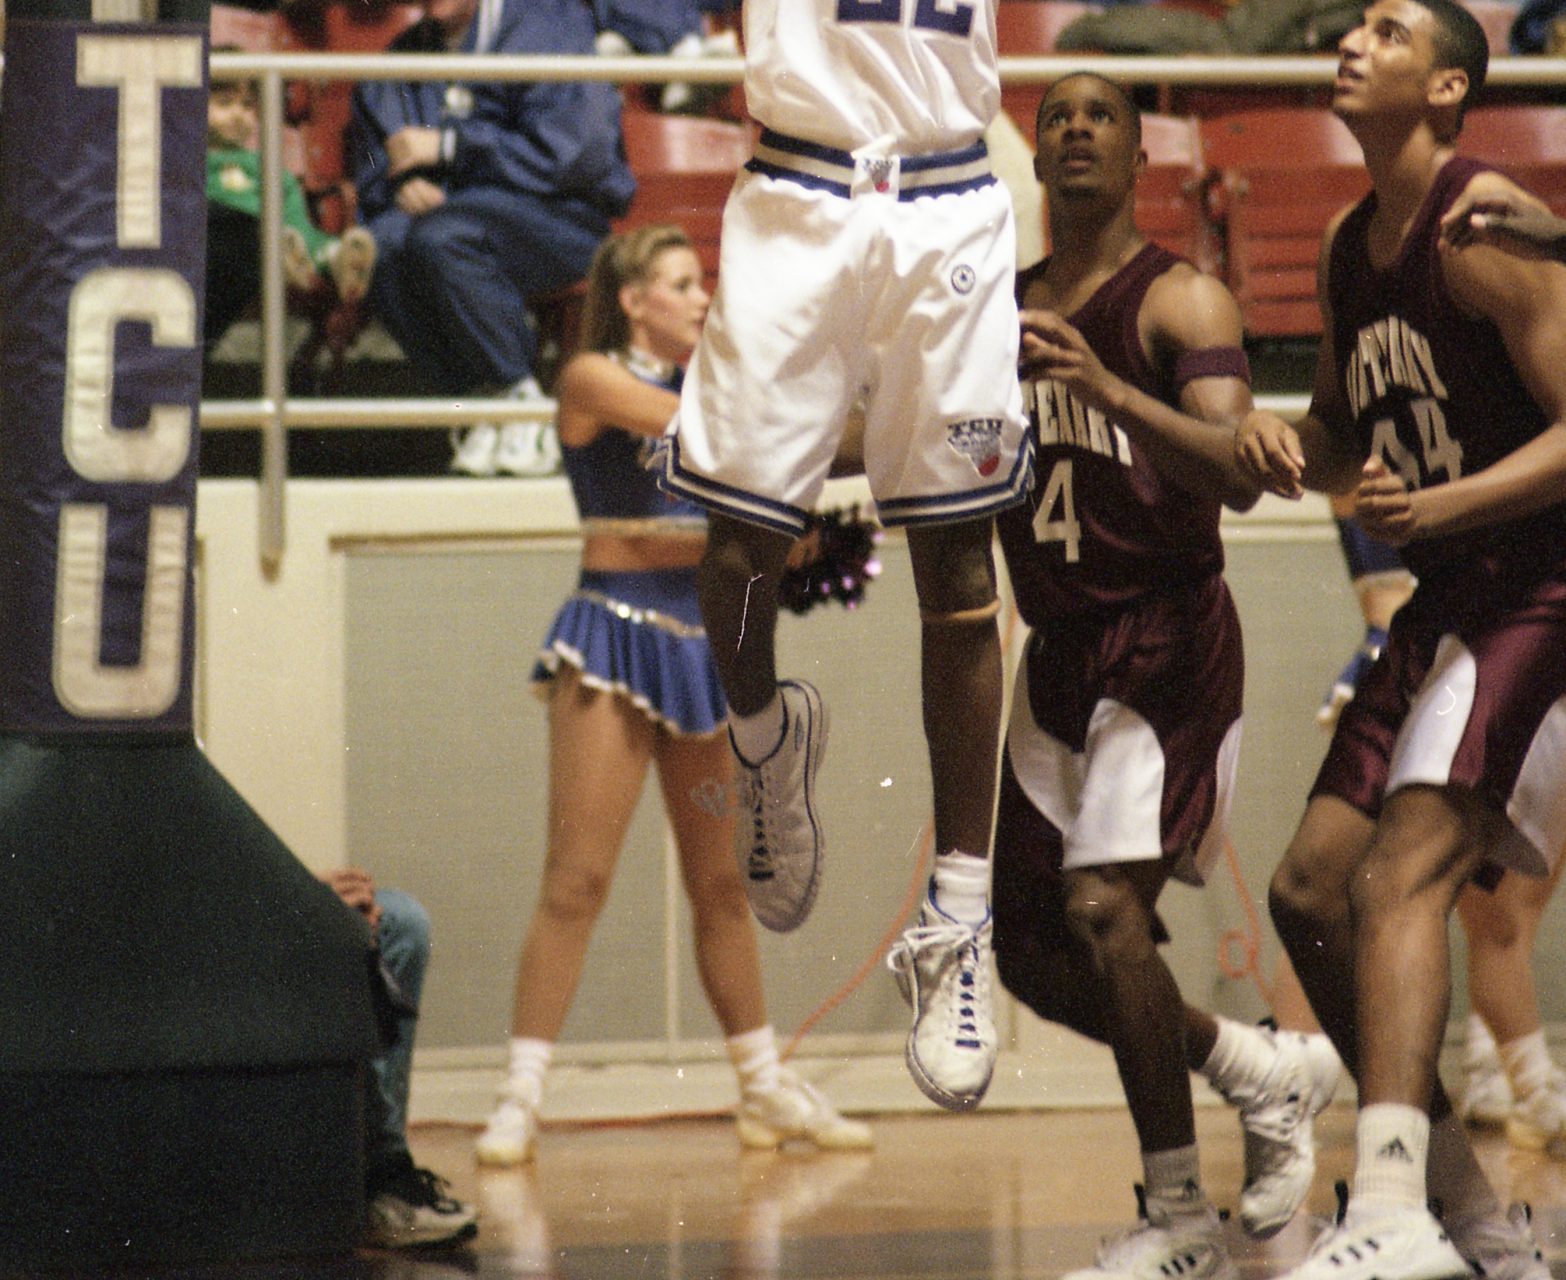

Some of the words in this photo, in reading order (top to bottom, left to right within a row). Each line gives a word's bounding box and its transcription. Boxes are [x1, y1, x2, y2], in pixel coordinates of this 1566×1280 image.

[52, 35, 202, 719] TCU
[1364, 397, 1463, 494] 44
[1032, 458, 1081, 563] 4
